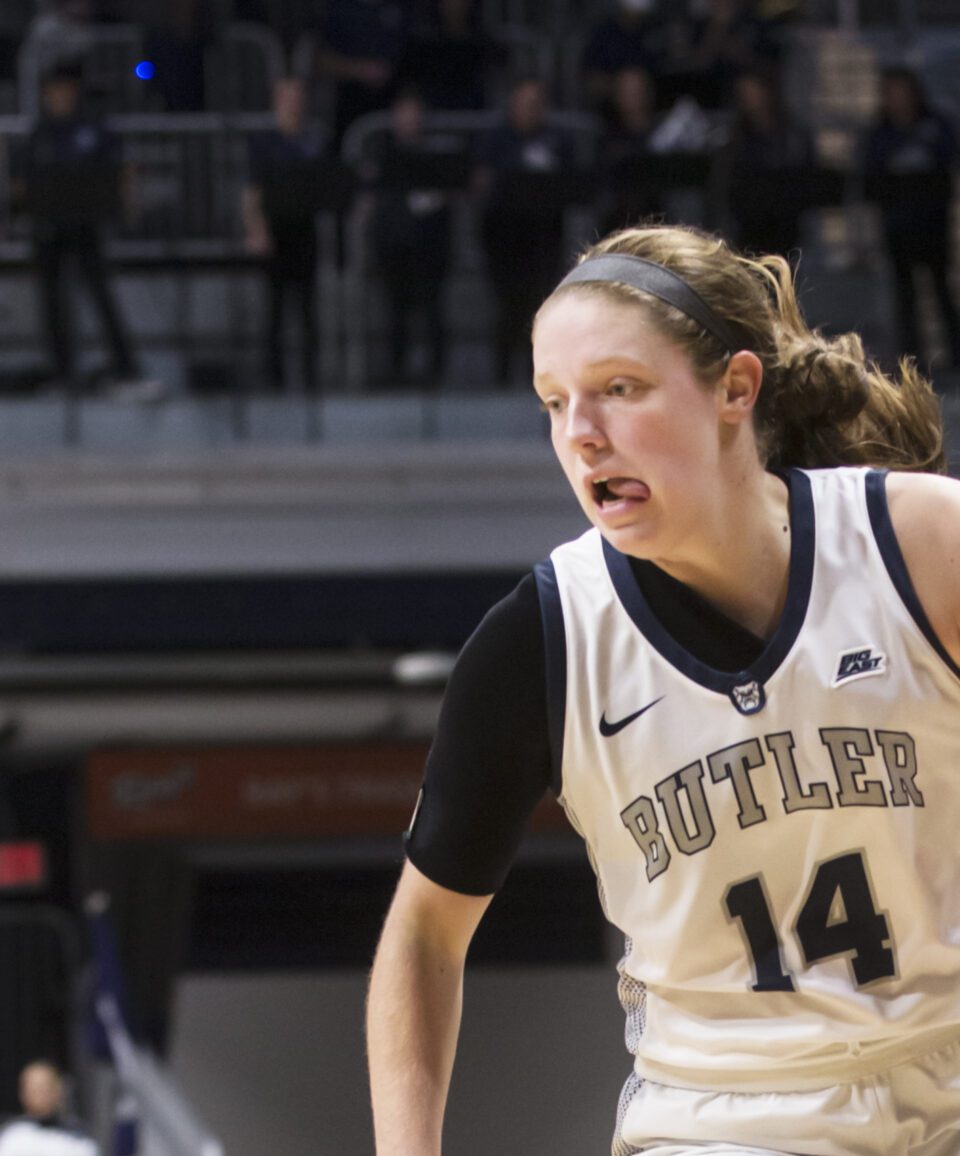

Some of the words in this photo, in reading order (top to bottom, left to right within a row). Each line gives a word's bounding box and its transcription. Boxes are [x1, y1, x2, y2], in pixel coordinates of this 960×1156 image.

[837, 656, 882, 681] EAST
[841, 649, 872, 663] BIG
[620, 727, 925, 883] BUTLER
[723, 847, 901, 993] 14
